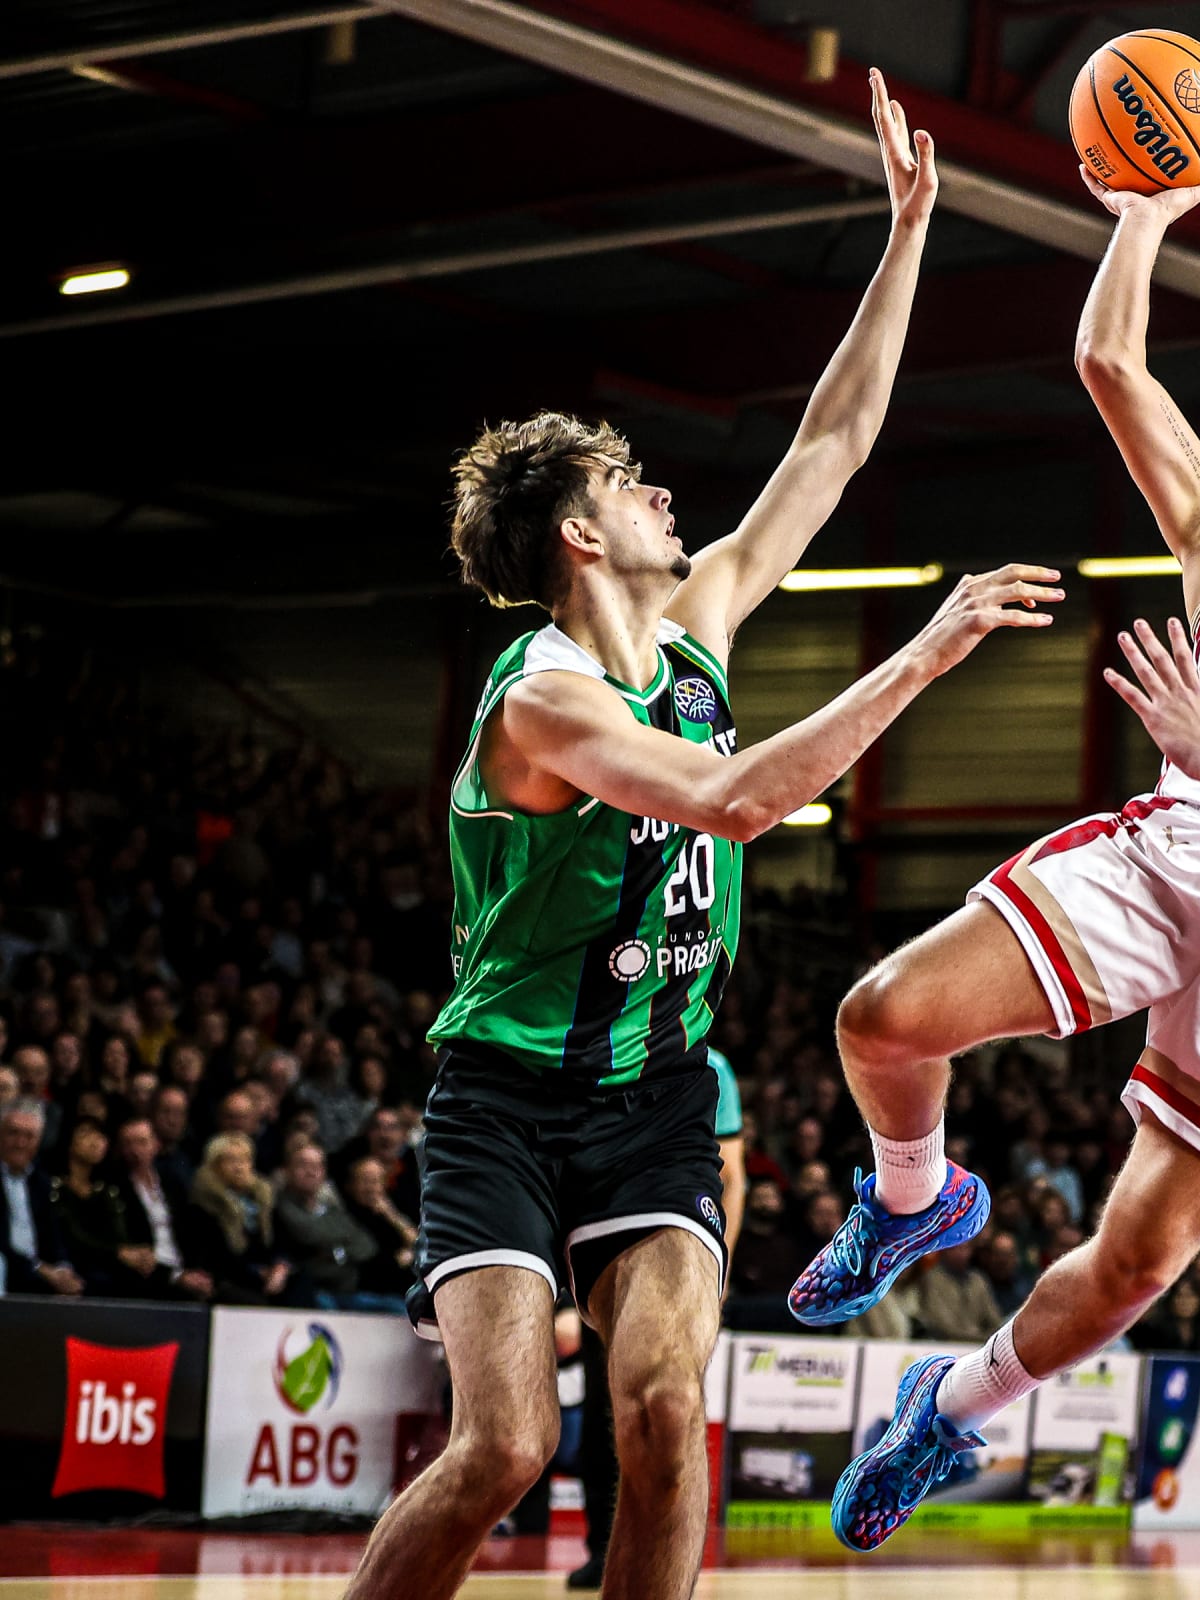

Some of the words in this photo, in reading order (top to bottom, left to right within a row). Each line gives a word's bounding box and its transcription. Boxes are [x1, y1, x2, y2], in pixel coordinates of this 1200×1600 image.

[1112, 73, 1191, 180] Wilson
[1085, 147, 1113, 179] FIBA
[663, 832, 716, 918] 20
[75, 1379, 157, 1446] ibis
[245, 1421, 360, 1489] ABG
